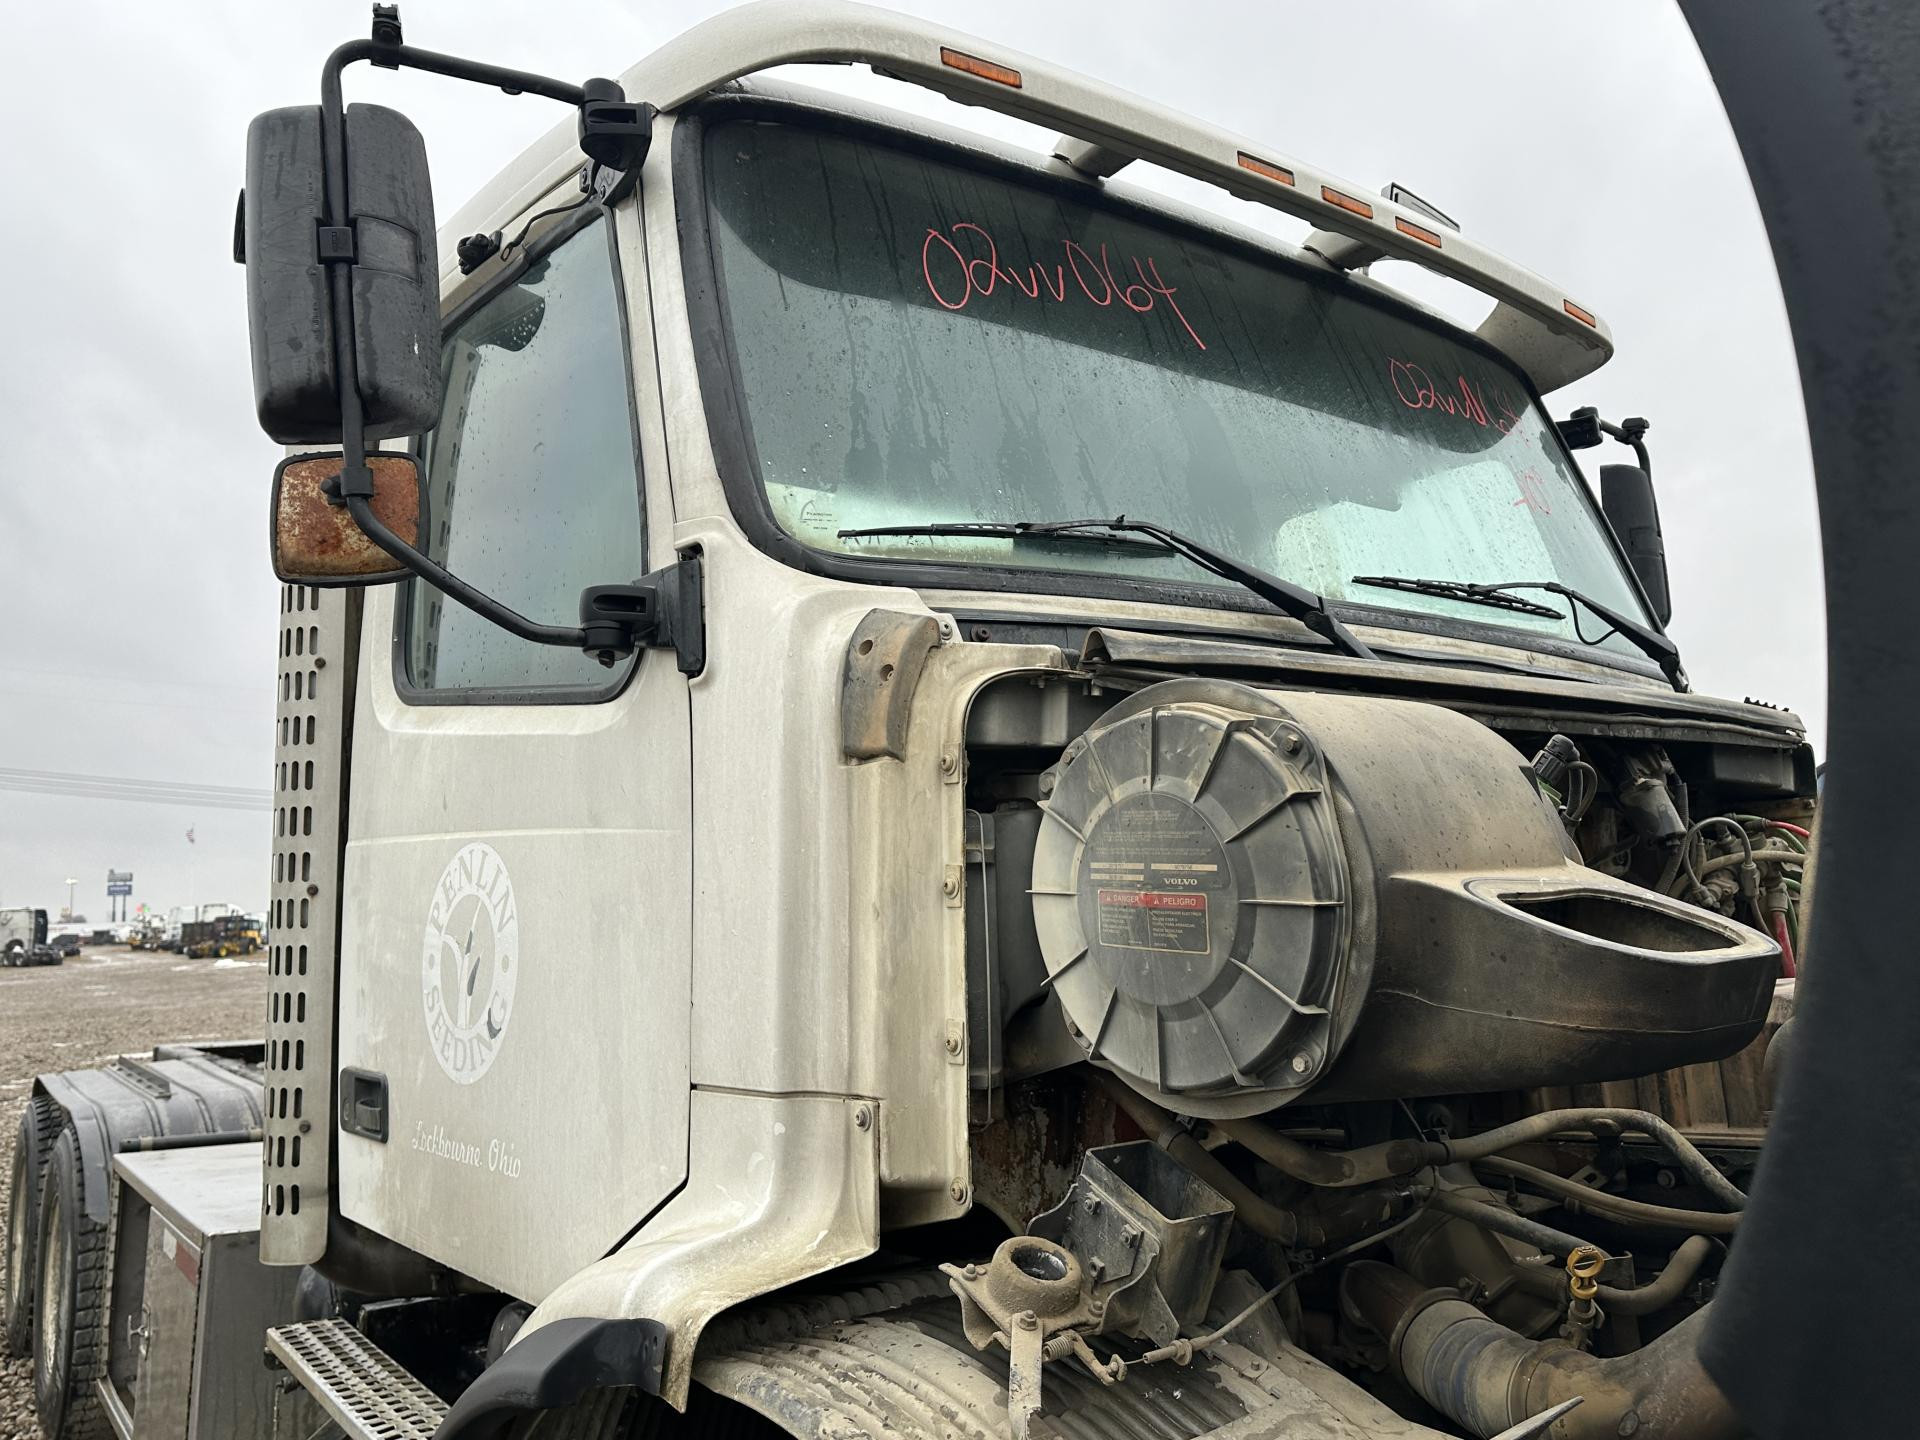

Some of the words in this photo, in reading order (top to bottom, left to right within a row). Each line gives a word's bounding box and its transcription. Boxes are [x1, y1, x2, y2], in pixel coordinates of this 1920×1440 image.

[430, 848, 516, 934] PENLIN
[1164, 877, 1197, 885] VOLVO
[1113, 894, 1139, 903] DANGER
[1163, 897, 1197, 906] PELIGRO
[425, 985, 507, 1073] SEEDING
[488, 1138, 521, 1178] Ohio
